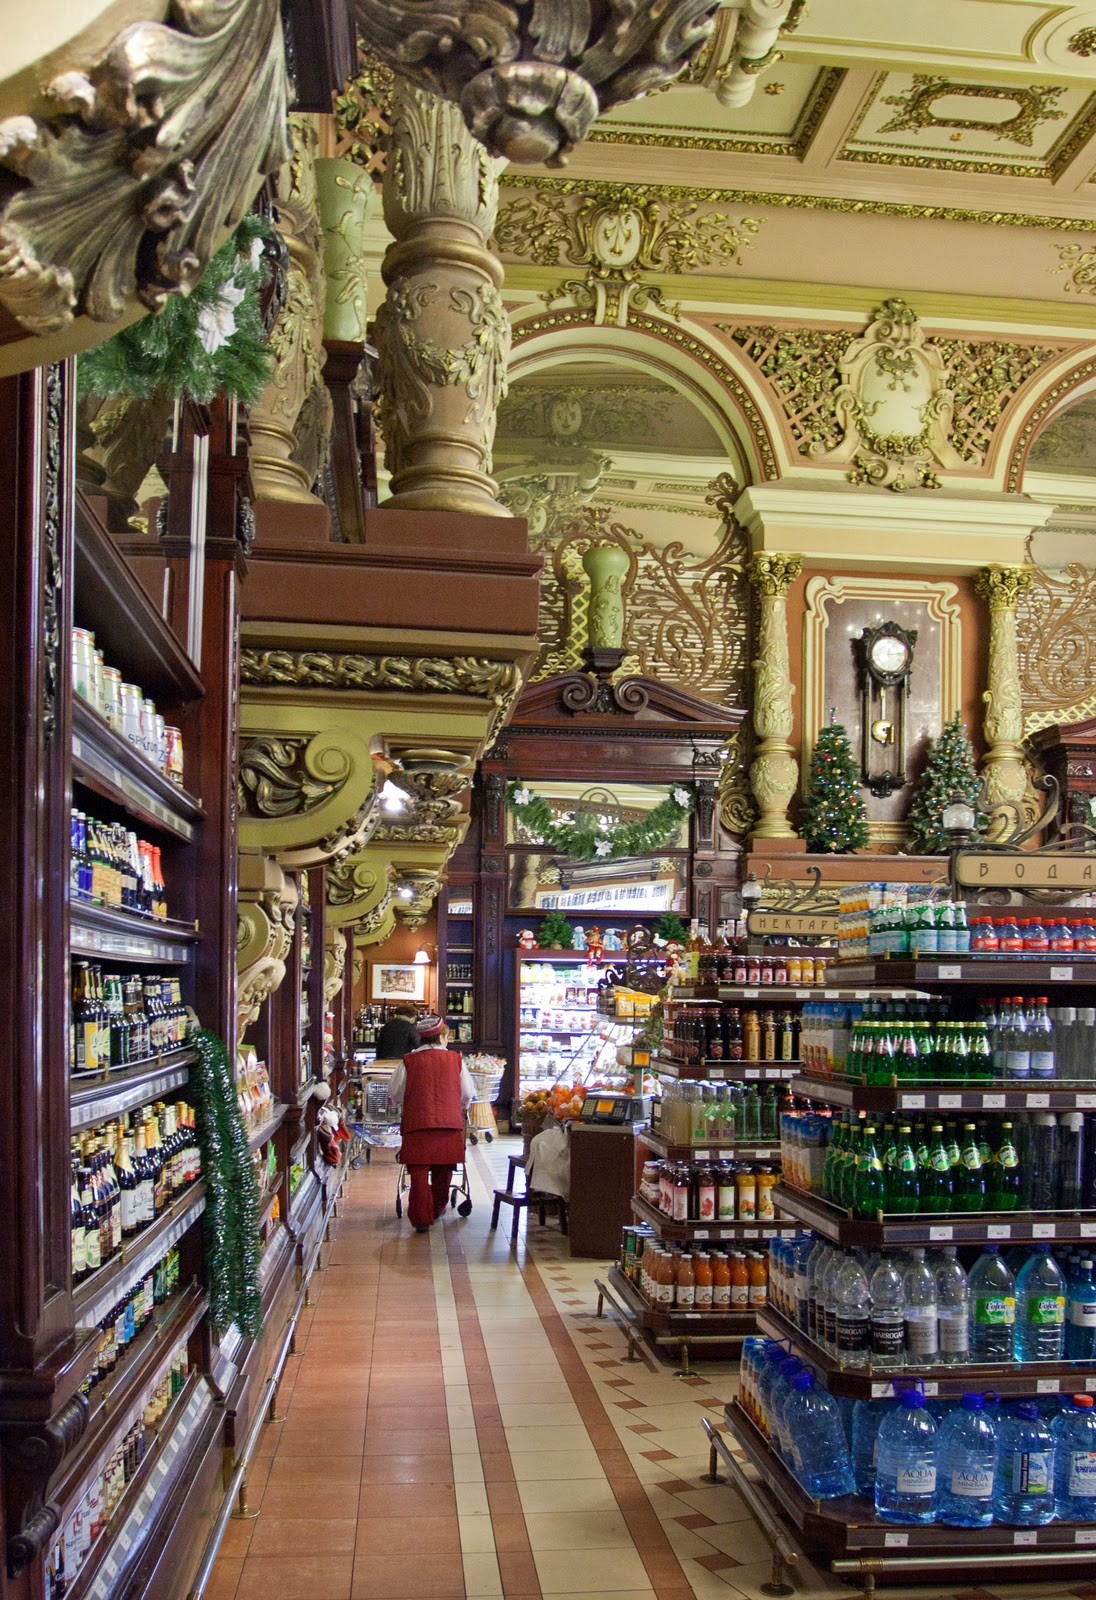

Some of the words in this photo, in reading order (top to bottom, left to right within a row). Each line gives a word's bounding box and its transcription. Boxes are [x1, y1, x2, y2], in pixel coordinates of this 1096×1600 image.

[979, 863, 1093, 880] ВОДА
[873, 1330, 904, 1339] HARROGAT
[903, 1469, 932, 1480] AQUA
[957, 1472, 989, 1483] AQUA
